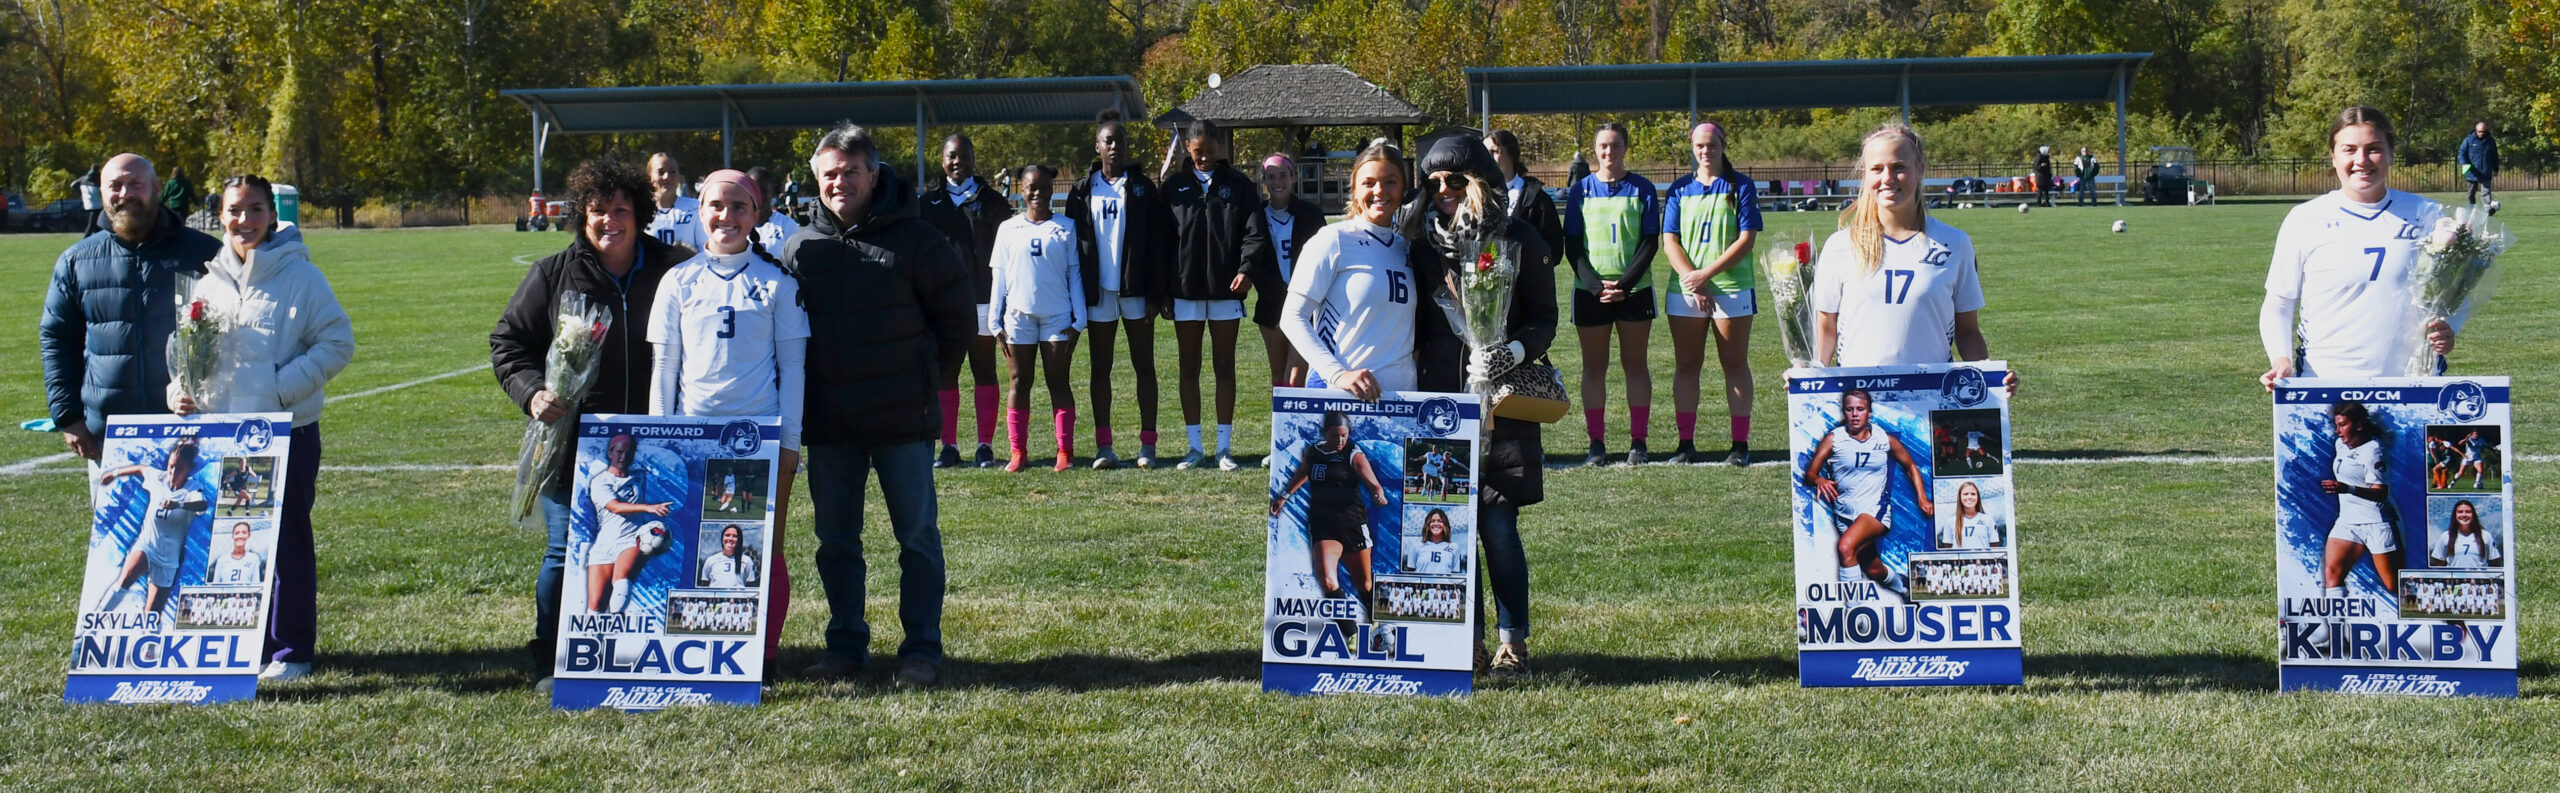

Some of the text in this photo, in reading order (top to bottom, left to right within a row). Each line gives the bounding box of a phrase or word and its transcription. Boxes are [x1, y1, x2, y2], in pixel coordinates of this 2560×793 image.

[1102, 199, 1118, 219] 14
[657, 229, 675, 246] 10
[1611, 223, 1617, 243] 1
[1700, 222, 1711, 243] 0
[2394, 223, 2424, 240] LC
[1031, 238, 1042, 257] 9
[1281, 239, 1292, 260] 5
[1919, 247, 1951, 266] LC
[2364, 247, 2386, 281] 7
[1386, 269, 1408, 304] 16
[1885, 269, 1915, 304] 17
[716, 306, 735, 339] 3
[1800, 378, 1900, 390] #17 D/MF
[2285, 390, 2401, 400] #7 CD/CM
[1283, 401, 1414, 414] #16 MIDFIELDER
[115, 426, 201, 436] #21 F/MF
[589, 426, 705, 436] #3 FORWARD
[1855, 452, 1871, 468] 17
[2336, 459, 2342, 474] 7
[1311, 463, 1327, 480] 16
[1965, 526, 1975, 537] 17
[1430, 551, 1441, 563] 16
[2462, 544, 2470, 555] 7
[231, 569, 241, 581] 21
[724, 562, 731, 572] 3
[1808, 583, 1880, 601] OLIVIA
[1275, 598, 1357, 618] MAYCEE
[2286, 598, 2376, 617] LAUREN
[83, 612, 159, 630] SKYLAR
[570, 615, 656, 633] NATALIE
[1807, 604, 2012, 643] MOUSER
[1273, 622, 1425, 662] GALL
[2286, 622, 2503, 662] KIRKBY
[80, 635, 250, 669] NICKEL
[566, 638, 748, 675] BLACK
[1851, 658, 1969, 680] TRAILBLAZERS
